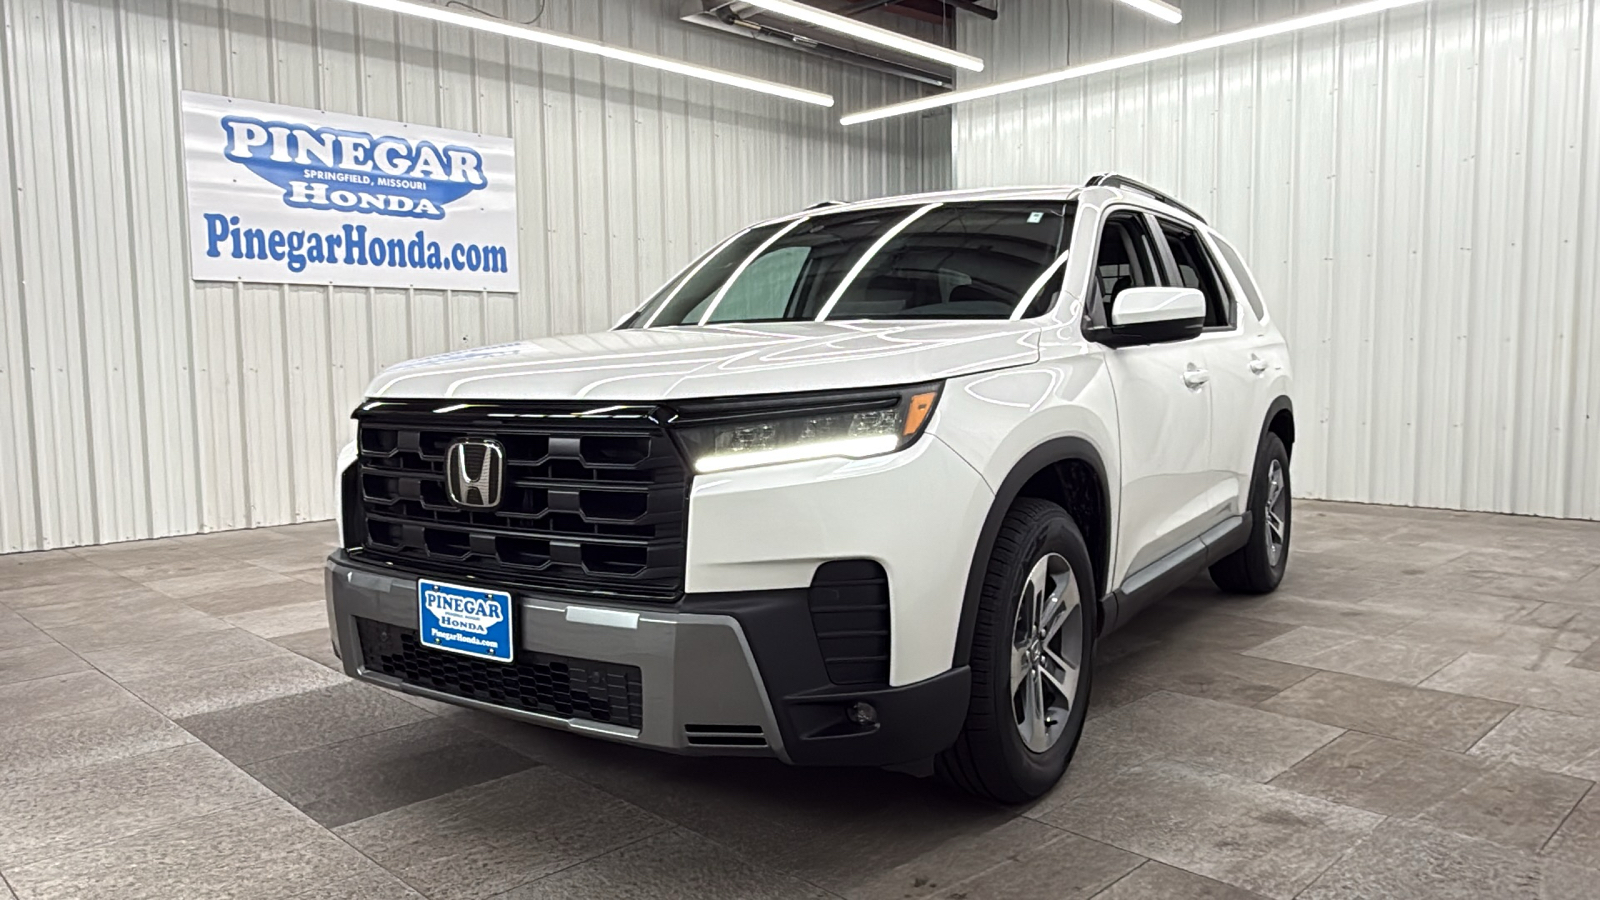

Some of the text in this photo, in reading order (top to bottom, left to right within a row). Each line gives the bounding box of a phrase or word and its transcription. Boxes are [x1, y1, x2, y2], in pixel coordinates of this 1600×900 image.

[228, 120, 484, 185] PINEGAR
[303, 168, 427, 191] SPRINGFIELD, MISSOURI
[289, 180, 440, 215] HONDA
[204, 213, 508, 273] PinegarHonda.com
[427, 593, 500, 619] PINEGAR
[441, 616, 485, 632] HONDA
[431, 627, 498, 648] PinegarHonda.com
